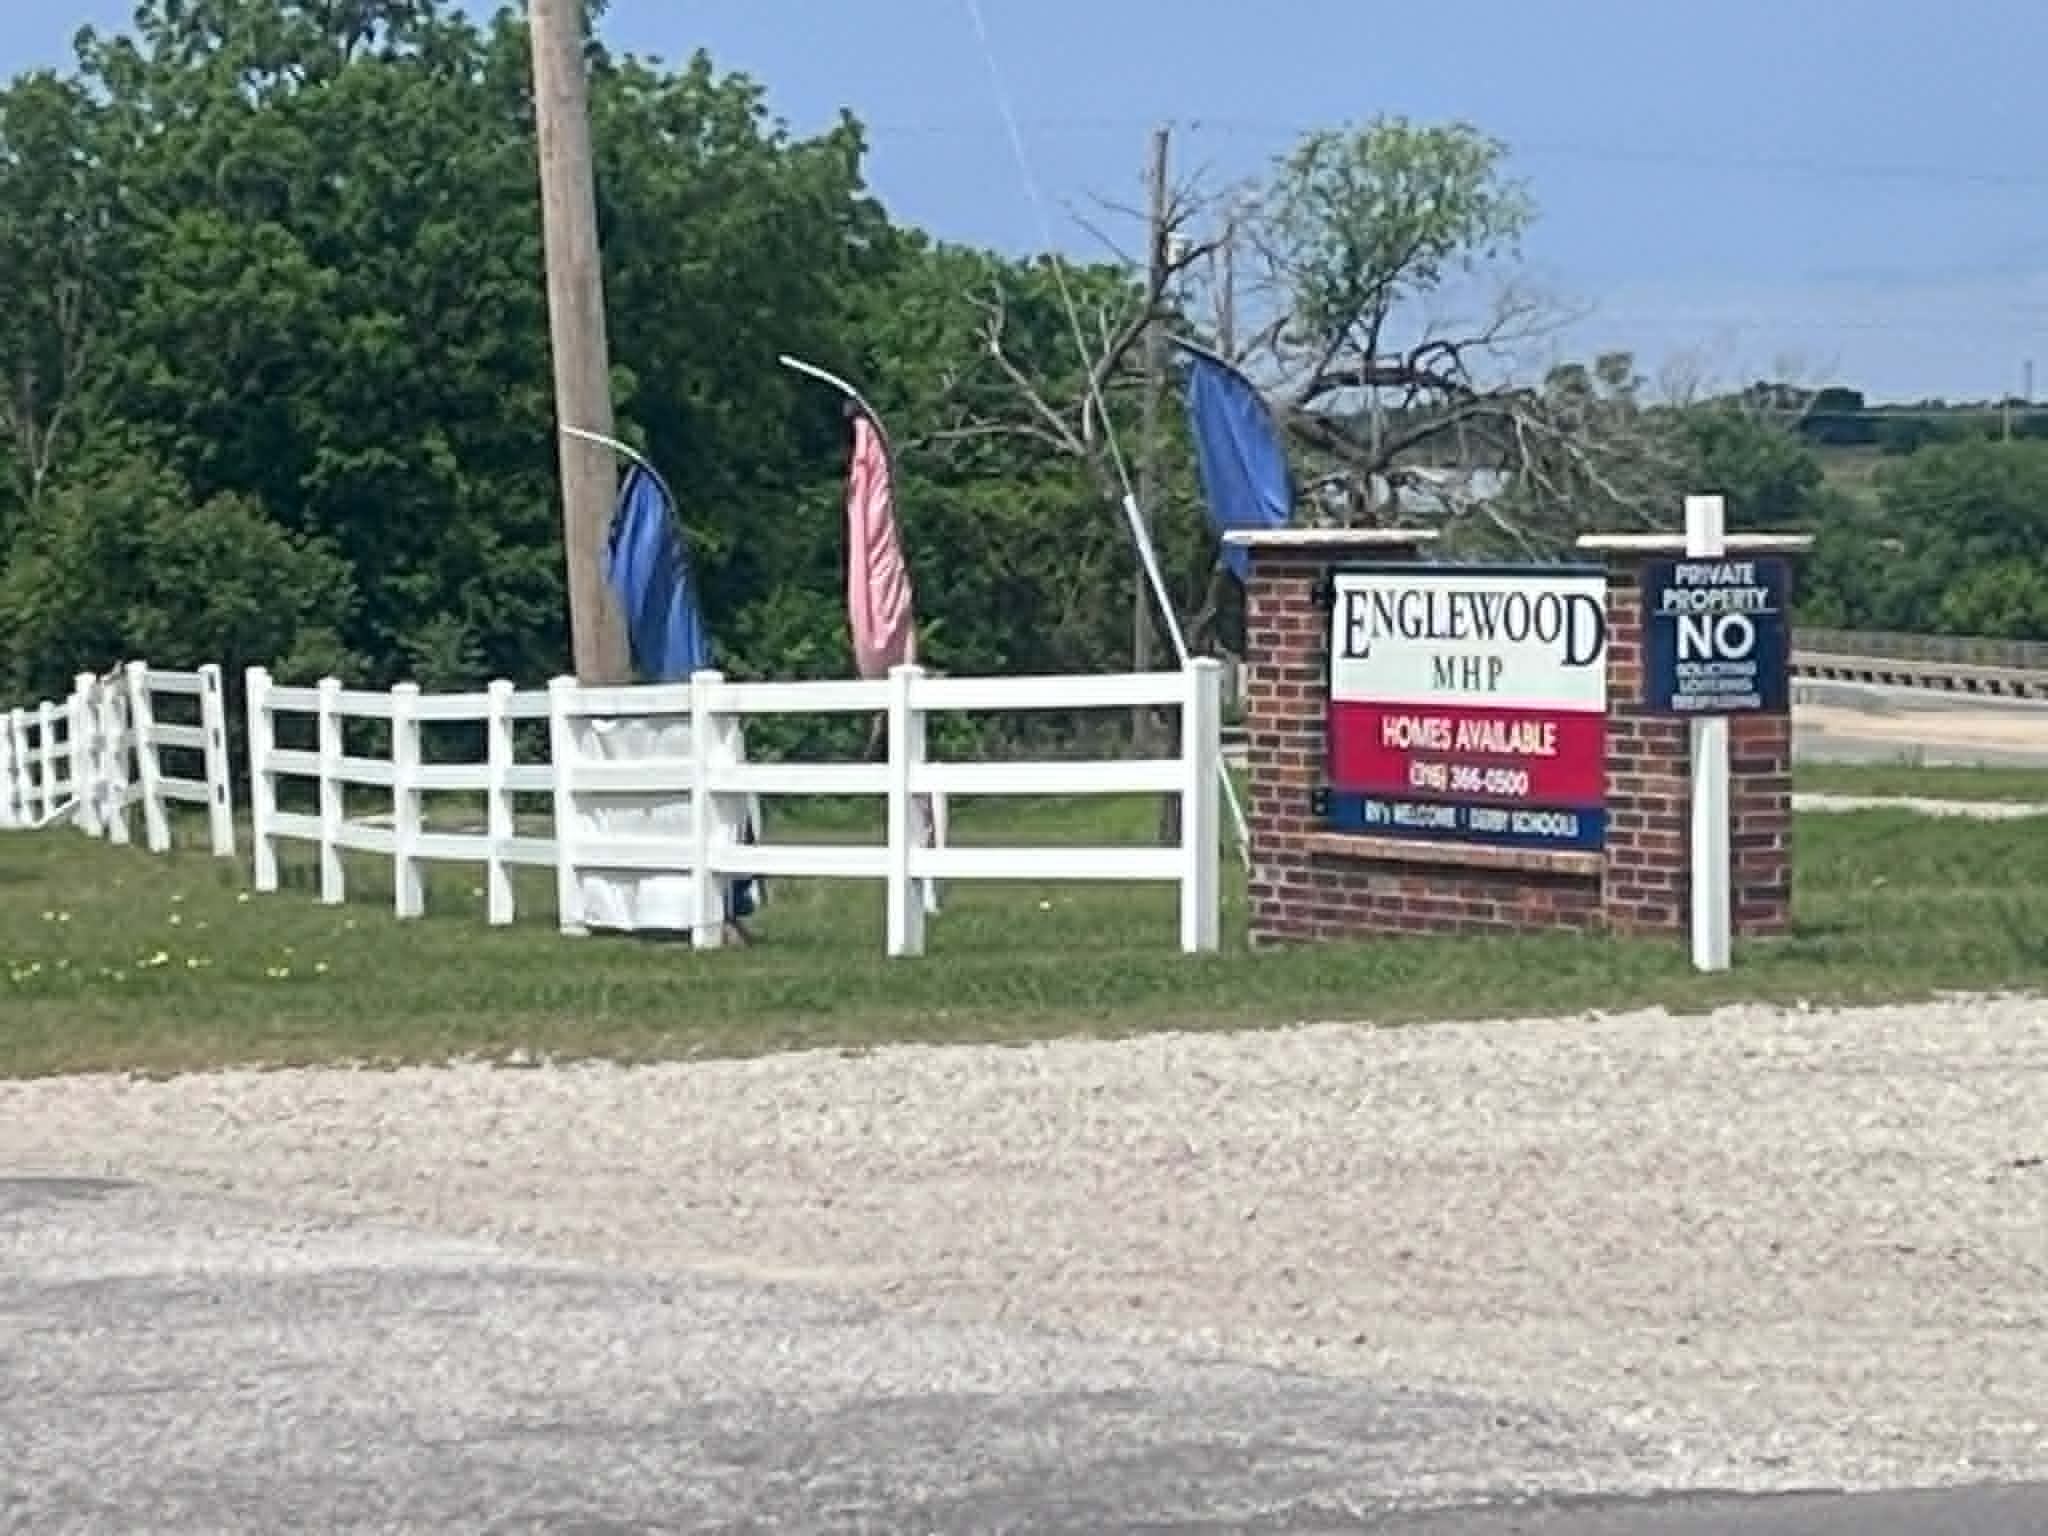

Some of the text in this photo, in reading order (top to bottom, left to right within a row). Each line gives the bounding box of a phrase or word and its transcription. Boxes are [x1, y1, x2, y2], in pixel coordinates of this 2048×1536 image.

[1675, 562, 1755, 585] PRIVATE
[1663, 587, 1769, 609] PROPERTY
[1340, 588, 1606, 667] ENGLEWOOD
[1678, 613, 1755, 660] NO
[1432, 655, 1503, 691] MHP
[1381, 716, 1558, 756] HOMES AVAILABLE
